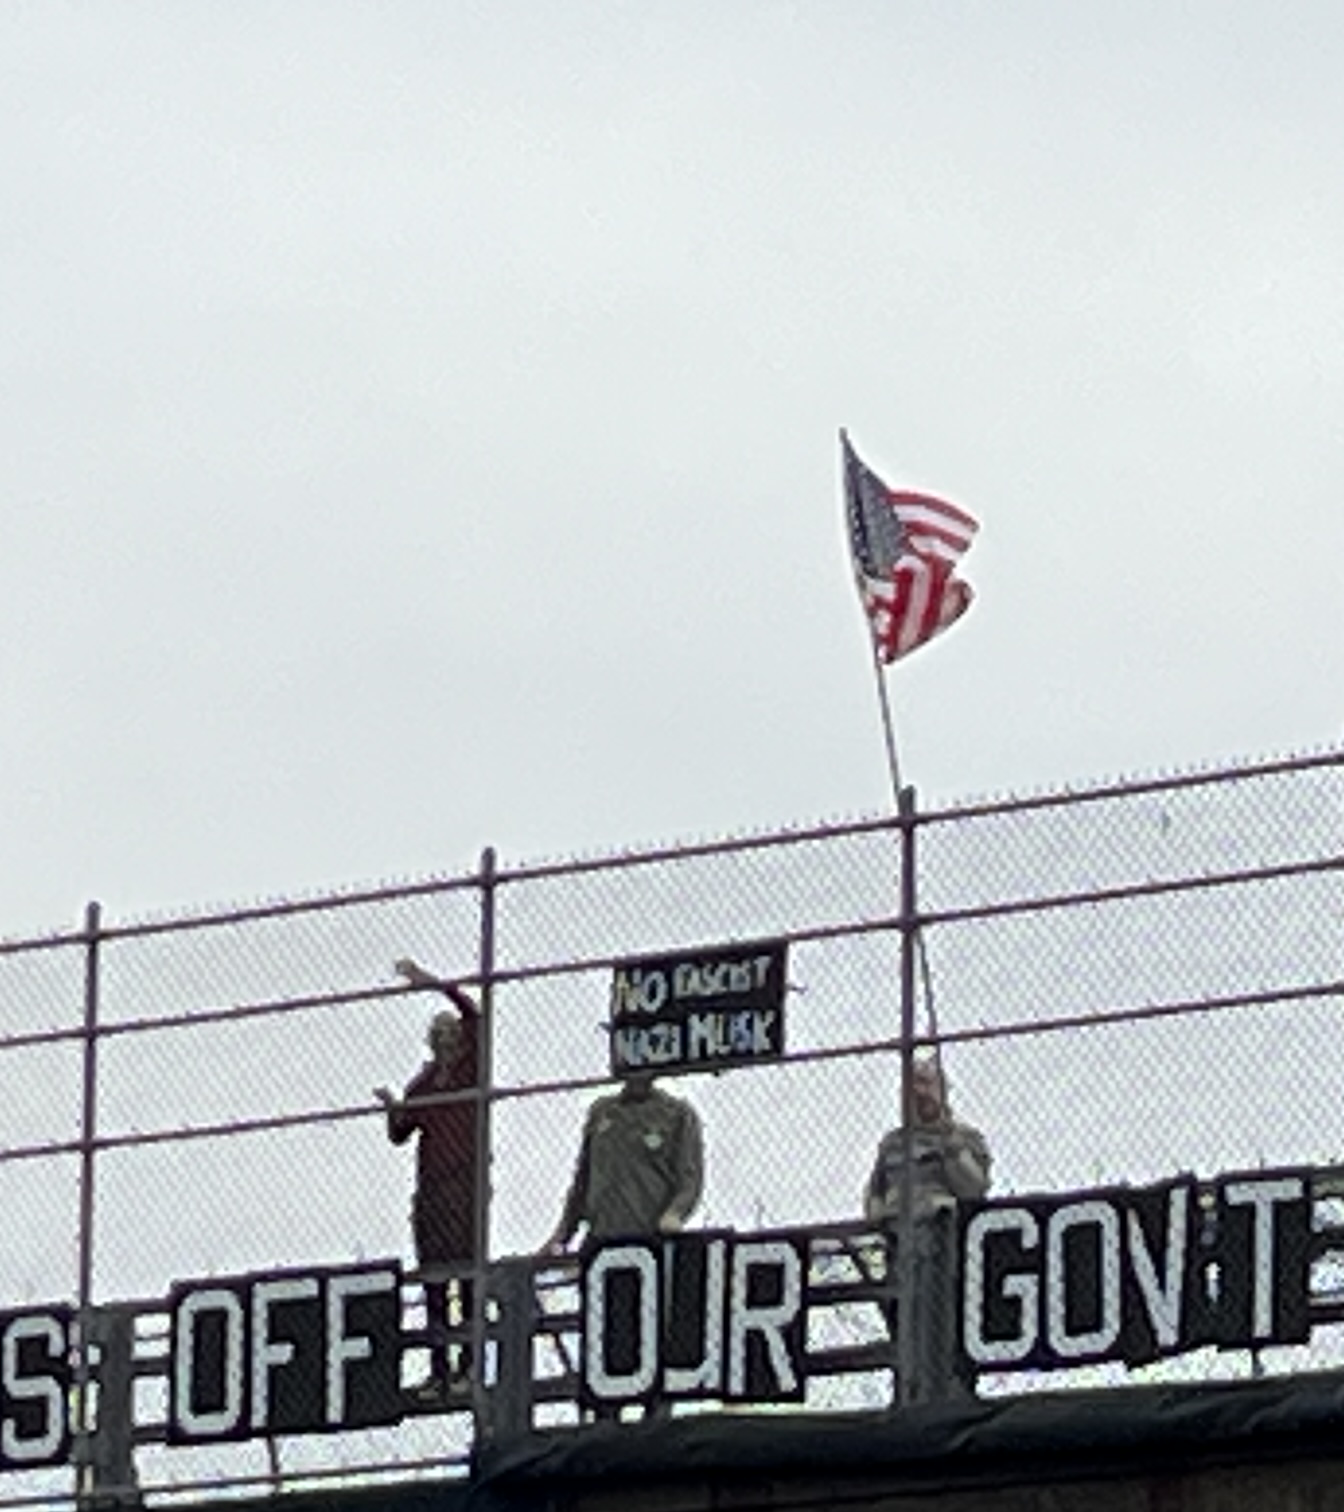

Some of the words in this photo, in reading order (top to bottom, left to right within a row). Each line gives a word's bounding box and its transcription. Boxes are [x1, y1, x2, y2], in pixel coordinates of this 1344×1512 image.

[614, 968, 668, 1014] NO
[688, 1010, 776, 1060] MUSK
[177, 1271, 398, 1436] OFF
[585, 1239, 802, 1398] OUR
